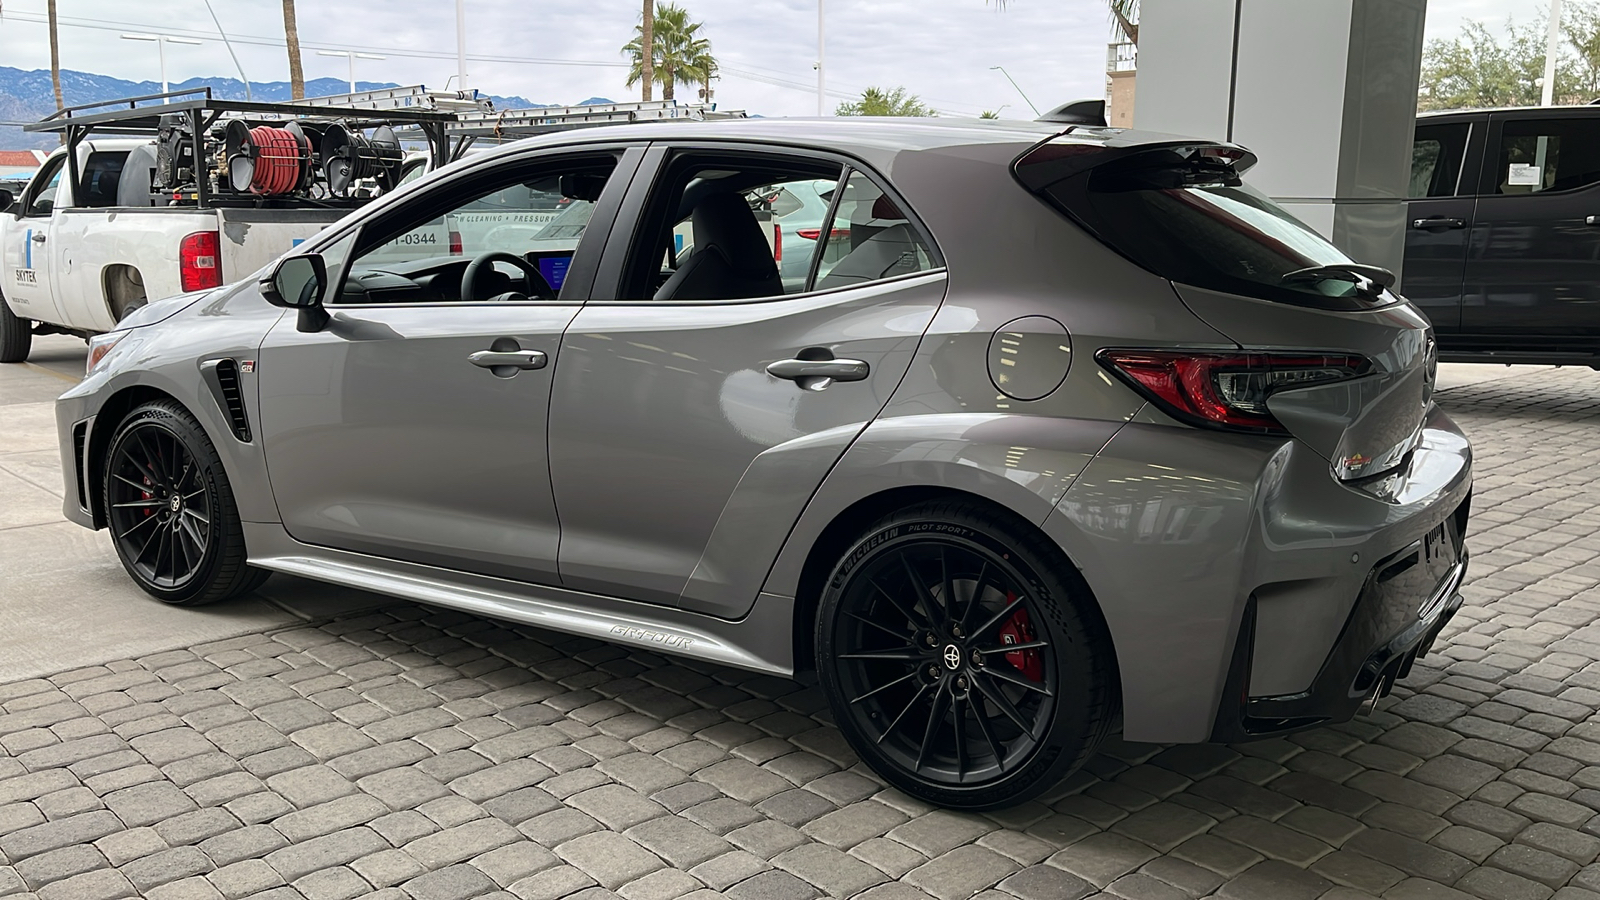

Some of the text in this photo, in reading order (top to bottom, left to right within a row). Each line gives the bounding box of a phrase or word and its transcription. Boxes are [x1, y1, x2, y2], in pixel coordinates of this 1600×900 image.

[466, 215, 503, 223] CLEANING
[15, 269, 37, 283] SKYTEK
[843, 527, 899, 573] MICHELIN
[908, 523, 935, 532] PILOT
[936, 524, 968, 535] SPORT
